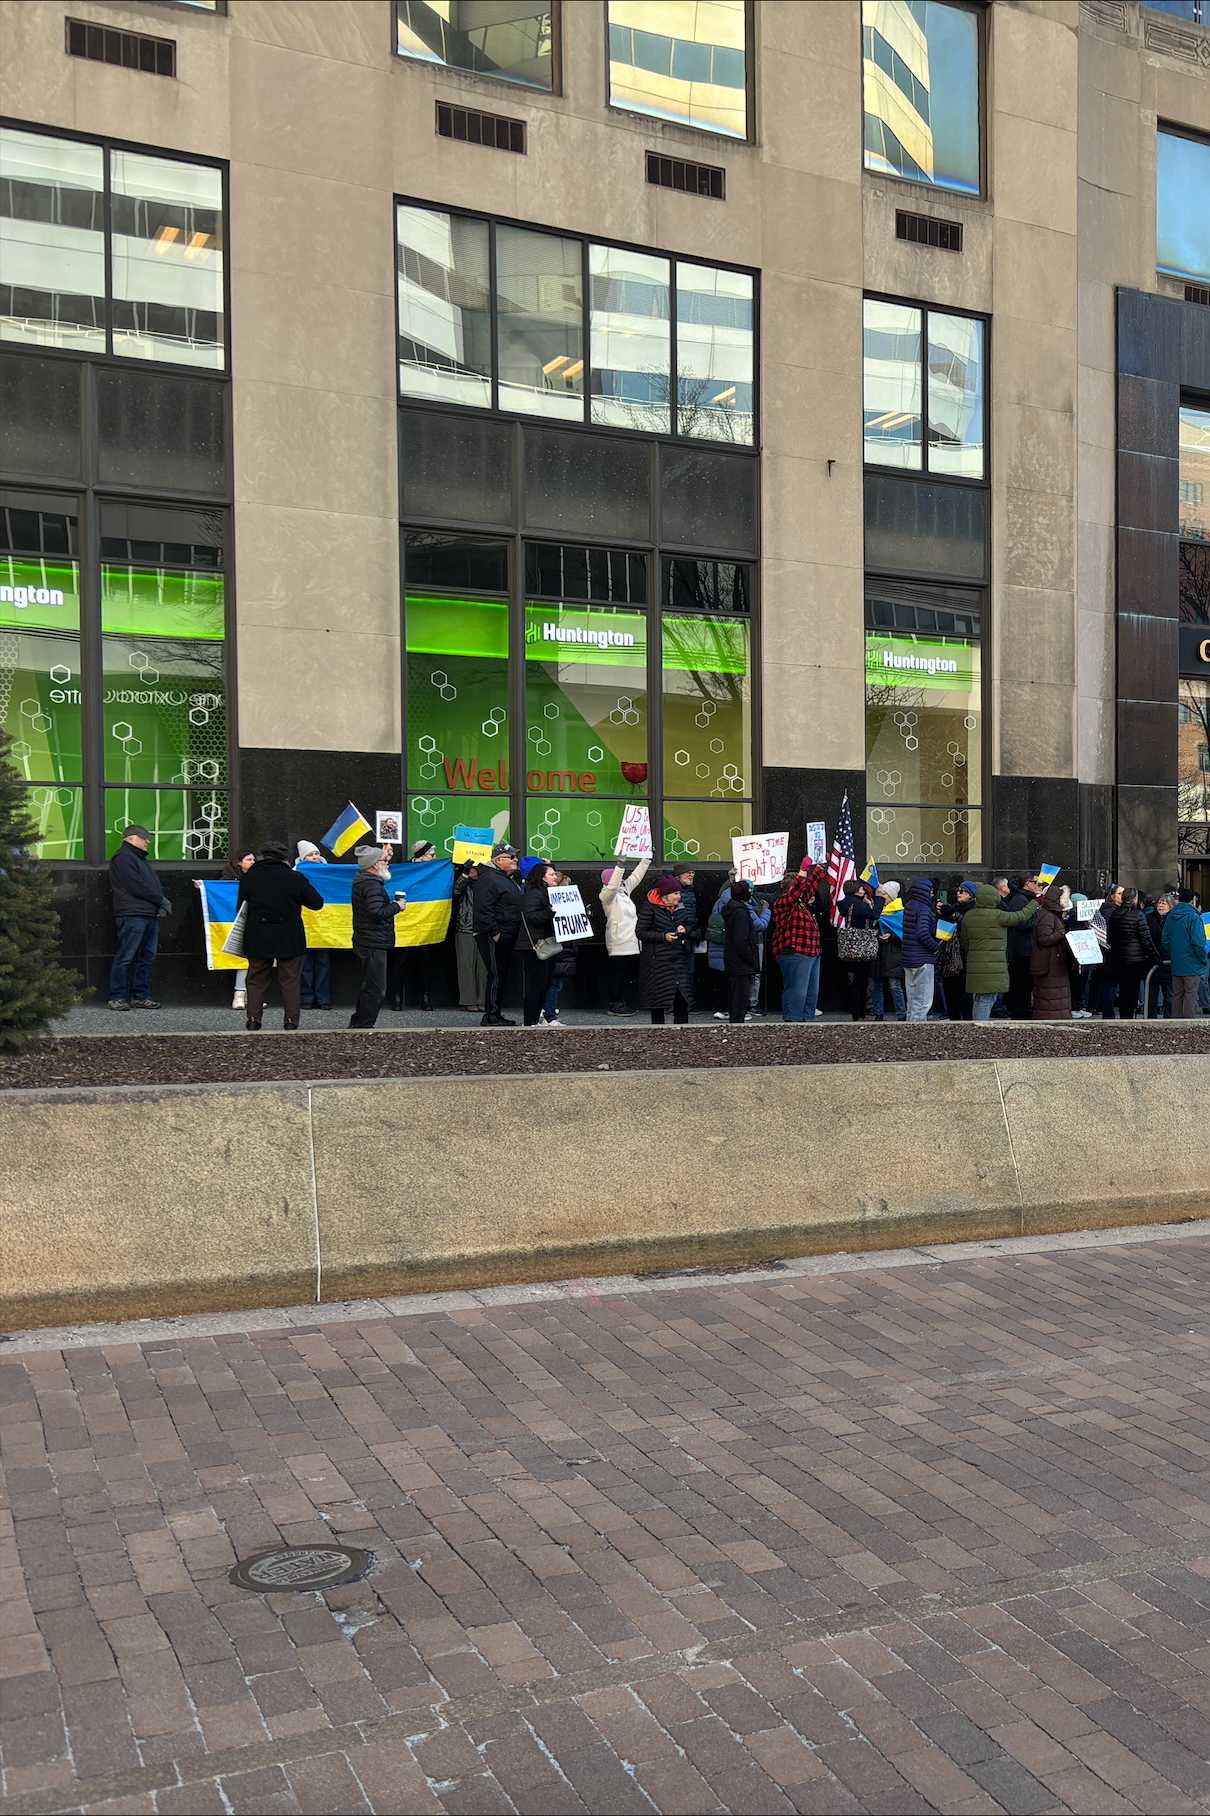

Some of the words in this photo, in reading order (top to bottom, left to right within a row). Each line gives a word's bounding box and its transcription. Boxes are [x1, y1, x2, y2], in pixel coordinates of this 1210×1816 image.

[543, 623, 634, 649] Huntington
[883, 651, 957, 674] Huntington
[444, 757, 597, 792] Welome
[740, 858, 767, 882] Fight
[550, 891, 580, 904] IMPEACH
[555, 914, 588, 936] TRUMP
